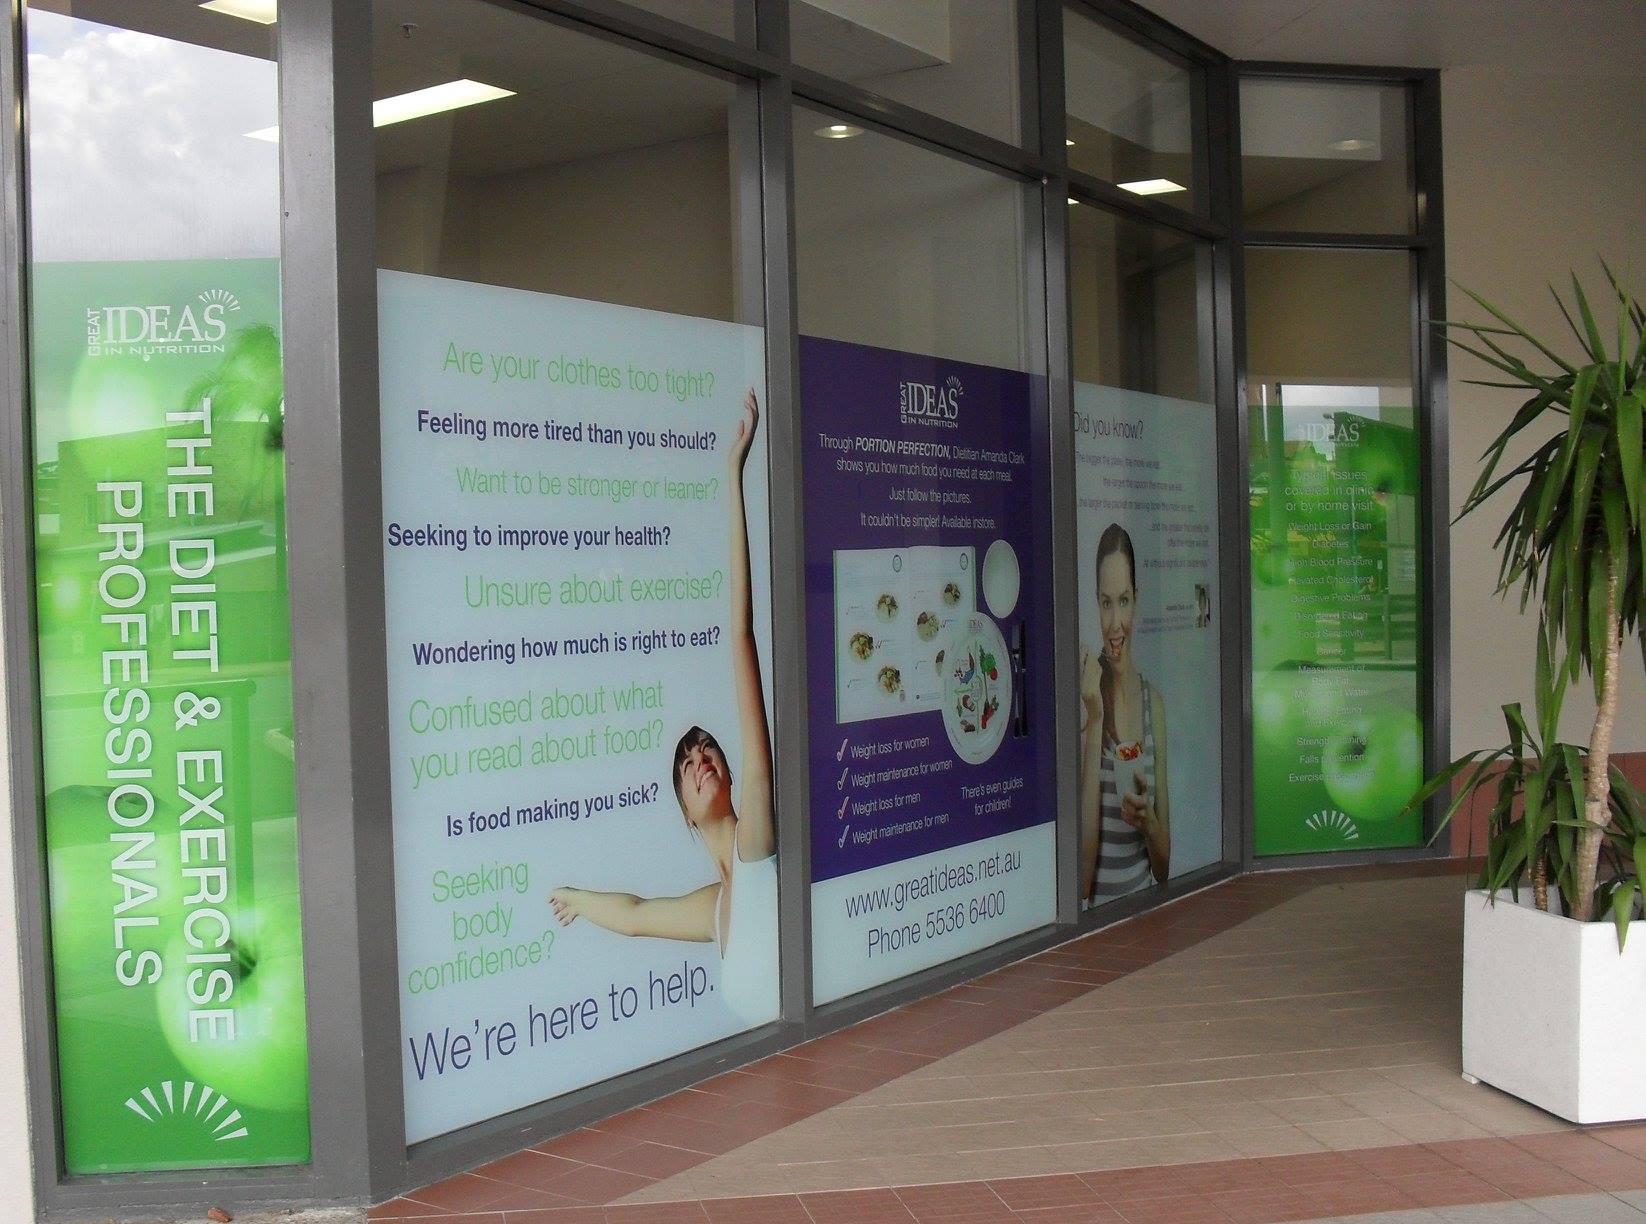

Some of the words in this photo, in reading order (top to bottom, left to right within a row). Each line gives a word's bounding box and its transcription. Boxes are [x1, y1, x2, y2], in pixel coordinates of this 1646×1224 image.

[87, 308, 101, 357] GREAT
[102, 304, 227, 343] IDEAS
[105, 347, 122, 355] IN
[130, 344, 225, 355] NUTRITION
[443, 342, 483, 374] Are
[491, 352, 540, 382] your
[547, 354, 621, 390] clothes
[628, 364, 659, 392] too
[665, 368, 715, 402] tight?
[906, 382, 958, 420] IDEAS
[417, 410, 487, 441] Feeling
[493, 419, 538, 439] more
[544, 419, 583, 442] tired
[587, 422, 623, 445] than
[628, 430, 656, 450] you
[660, 428, 716, 451] should?
[908, 416, 916, 424] IN
[918, 418, 958, 428] NUTRITION
[1073, 411, 1090, 434] Did
[1093, 419, 1111, 440] you
[1112, 416, 1144, 440] know?
[165, 397, 214, 519] THE
[819, 433, 854, 453] Through
[855, 437, 896, 453] PORTION
[897, 440, 951, 460] PERFECTION,
[981, 449, 1007, 463] Amanda
[1008, 451, 1025, 464] Clark
[456, 466, 507, 494] Want
[513, 471, 531, 495] to
[539, 470, 562, 496] be
[568, 474, 637, 503] stronger
[643, 478, 658, 498] or
[665, 477, 718, 500] leaner?
[836, 457, 864, 472] shows
[865, 461, 880, 475] you
[881, 459, 898, 474] how
[899, 462, 920, 476] much
[921, 462, 938, 477] food
[939, 466, 952, 480] you
[952, 466, 970, 479] need
[971, 468, 978, 479] at
[979, 469, 995, 480] each
[889, 486, 905, 501] Just
[907, 487, 927, 502] follow
[929, 489, 941, 502] the
[943, 490, 972, 506] pictures.
[1286, 502, 1297, 511] or
[1300, 501, 1313, 514] by
[1317, 501, 1349, 511] home
[388, 522, 467, 551] Seeking
[473, 525, 492, 546] to
[498, 525, 569, 551] improve
[574, 530, 610, 550] your
[615, 525, 671, 546] health?
[860, 511, 866, 526] It
[867, 512, 899, 527] couldn't
[900, 513, 911, 527] be
[941, 515, 972, 528] Available
[168, 538, 220, 674] DIET
[464, 573, 552, 608] Unsure
[560, 573, 623, 605] about
[631, 570, 723, 601] exercise?
[413, 639, 516, 666] Wondering
[521, 635, 558, 659] how
[564, 632, 609, 656] much
[614, 631, 627, 652] is
[632, 629, 668, 651] right
[671, 630, 687, 649] to
[690, 626, 720, 647] eat?
[173, 690, 222, 732] &
[409, 690, 533, 734] Confused
[541, 685, 607, 718] about
[615, 681, 664, 713] what
[96, 481, 164, 988] PROFESSIONALS
[410, 750, 459, 789] you
[469, 734, 523, 773] read
[531, 732, 598, 766] about
[604, 719, 664, 756] food?
[850, 744, 876, 760] Weight
[878, 742, 893, 755] loss
[893, 739, 904, 752] for
[904, 737, 930, 750] women
[851, 772, 876, 788] Weight
[877, 765, 919, 782] maintenance
[919, 762, 929, 775] for
[929, 760, 953, 772] women
[961, 784, 986, 799] There's
[986, 782, 1002, 794] even
[1002, 777, 1024, 794] guides
[447, 814, 463, 838] Is
[468, 806, 511, 834] food
[517, 799, 580, 826] making
[584, 791, 615, 818] you
[618, 782, 660, 808] sick?
[851, 800, 878, 816] Weight
[879, 798, 894, 810] loss
[894, 795, 905, 807] for
[905, 793, 921, 804] men
[974, 803, 984, 815] for
[852, 828, 878, 845] Weight
[879, 819, 923, 838] maintenance
[924, 815, 934, 828] for
[934, 813, 950, 824] men
[175, 748, 236, 1044] EXERCISE
[432, 860, 530, 903] Seeking
[845, 850, 1022, 918] www.greatideas.net.au
[453, 901, 514, 943] body
[868, 918, 921, 957] Phone
[926, 902, 965, 939] 5536
[969, 890, 1006, 924] 6400
[408, 930, 556, 995] confidence?
[409, 1018, 517, 1081] We're
[529, 997, 599, 1047] here
[608, 983, 639, 1022] to
[649, 960, 715, 1010] help.
